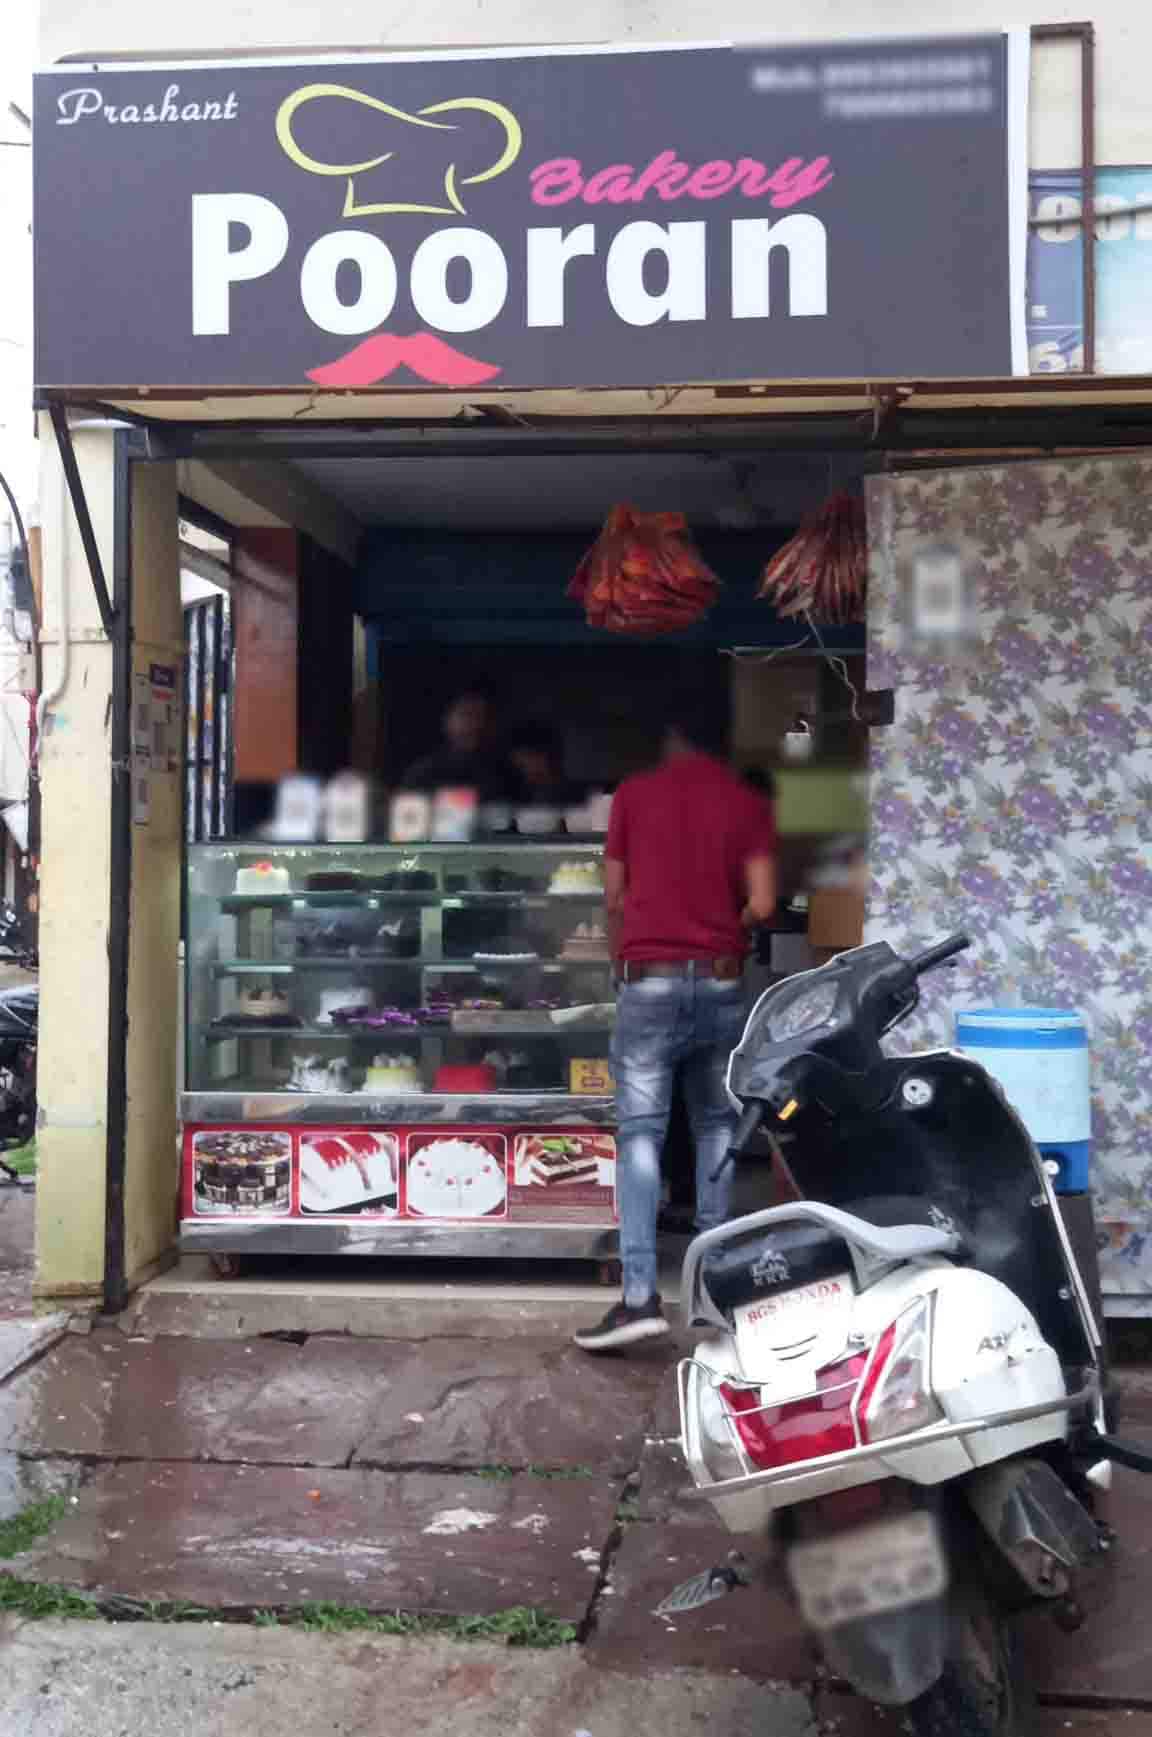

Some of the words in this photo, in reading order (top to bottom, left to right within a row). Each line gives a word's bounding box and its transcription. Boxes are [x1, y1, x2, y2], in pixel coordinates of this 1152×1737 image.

[56, 84, 239, 124] Prashant
[530, 149, 833, 208] Bakery
[191, 193, 829, 336] Pooran
